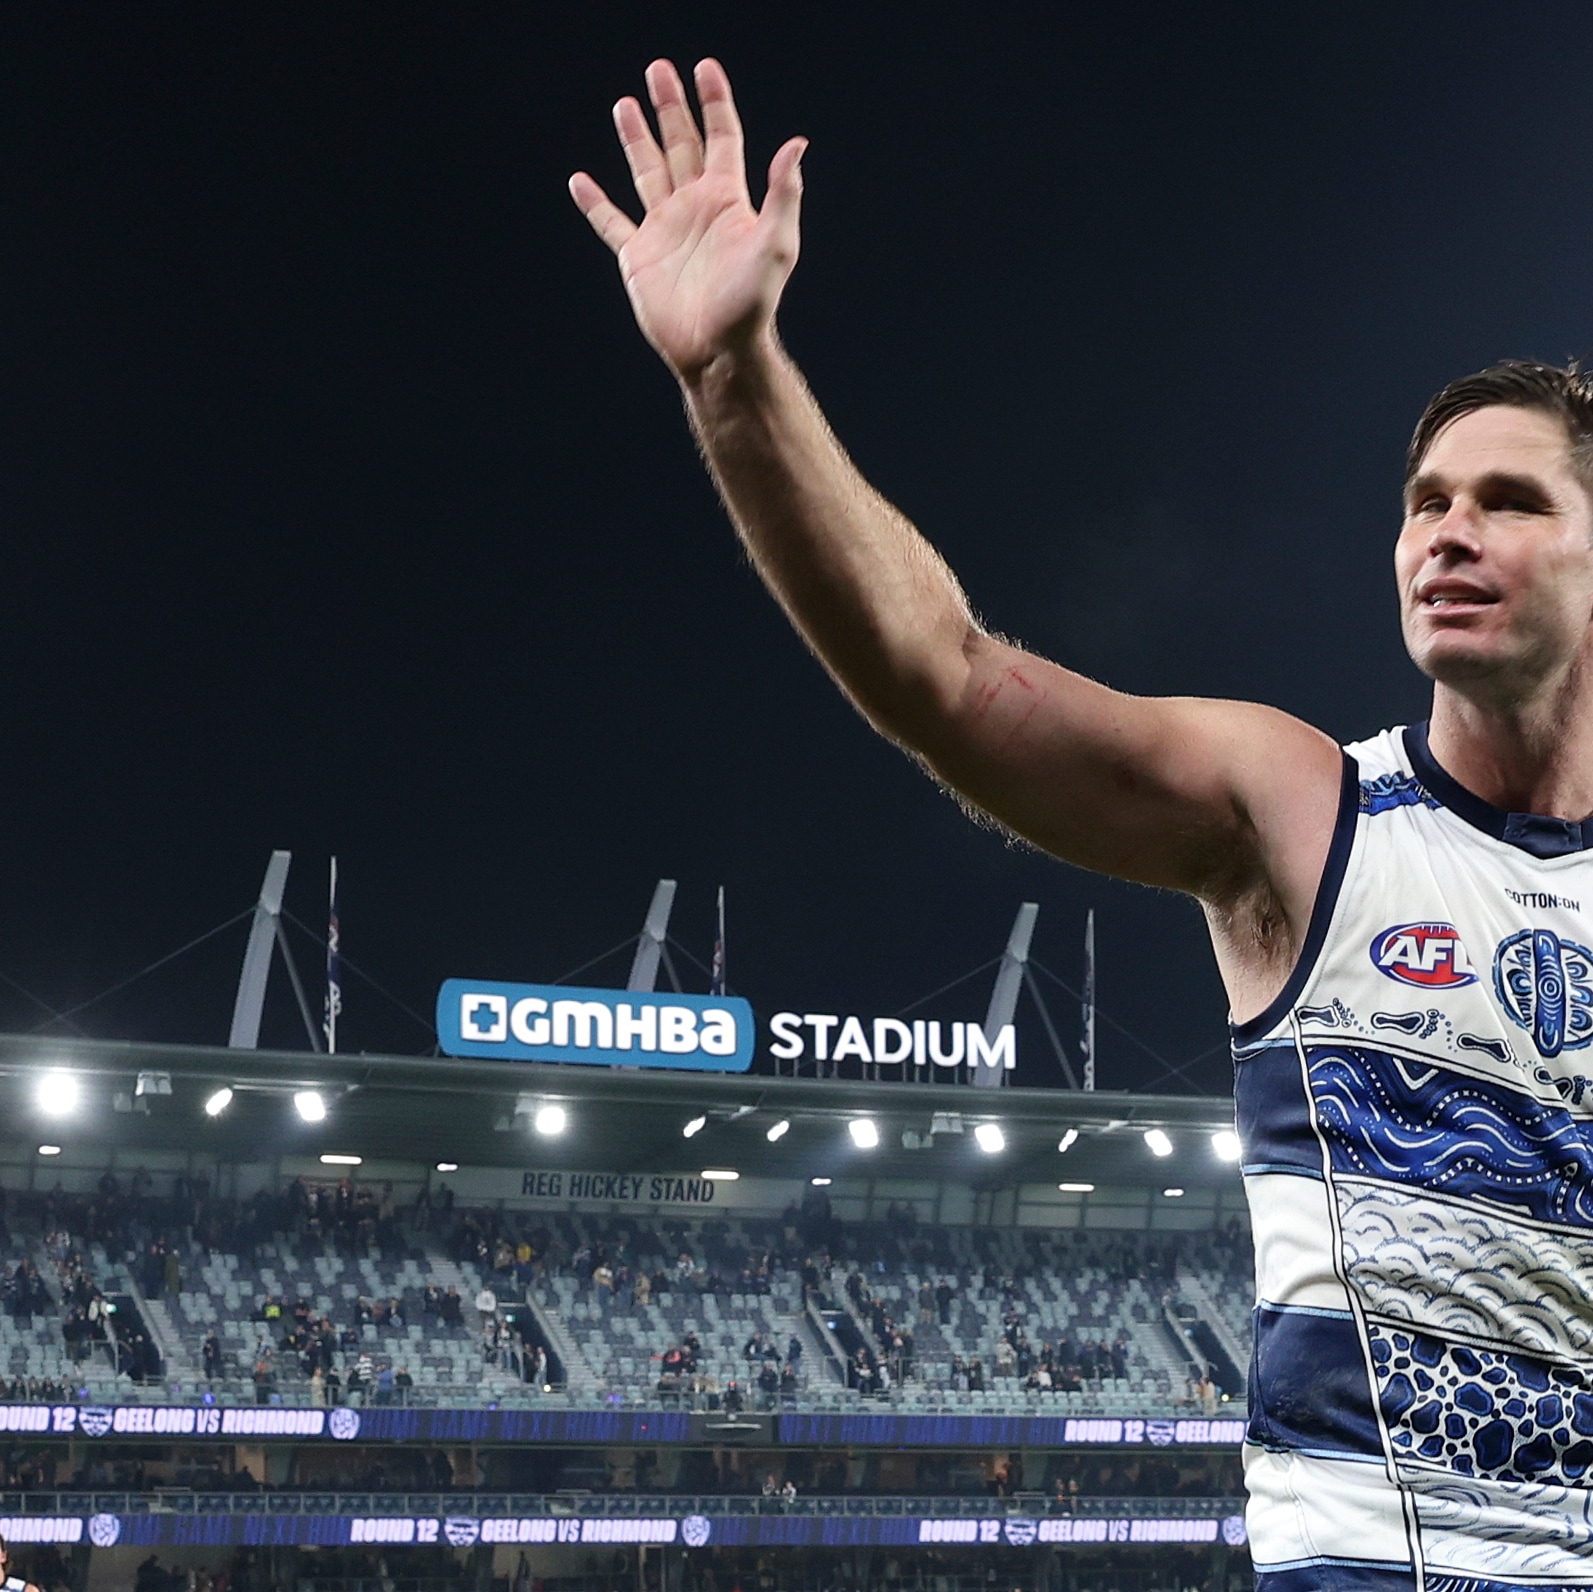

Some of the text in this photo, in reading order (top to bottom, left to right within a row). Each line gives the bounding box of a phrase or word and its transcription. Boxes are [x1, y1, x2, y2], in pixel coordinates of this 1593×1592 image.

[1378, 935, 1475, 974] AFL
[769, 1011, 1016, 1070] STADIUM
[522, 1172, 715, 1203] REG HICKEY STAND
[52, 1407, 76, 1432] 12
[112, 1408, 196, 1434] GEELONG
[196, 1409, 220, 1434] VS
[221, 1409, 325, 1435] RICHMOND
[1064, 1419, 1123, 1443] ROUND
[1123, 1420, 1145, 1443] 12
[1175, 1421, 1246, 1444] GEELONG
[350, 1519, 416, 1542] ROUND
[417, 1519, 439, 1542] 12
[481, 1518, 556, 1542] GEELONG
[558, 1519, 580, 1542] VS
[581, 1518, 677, 1542] RICHMOND
[919, 1520, 978, 1542] ROUND
[979, 1520, 1000, 1542] 12
[1038, 1520, 1108, 1542] GEELONG
[1109, 1520, 1128, 1541] VS
[1129, 1519, 1219, 1542] RICHMOND
